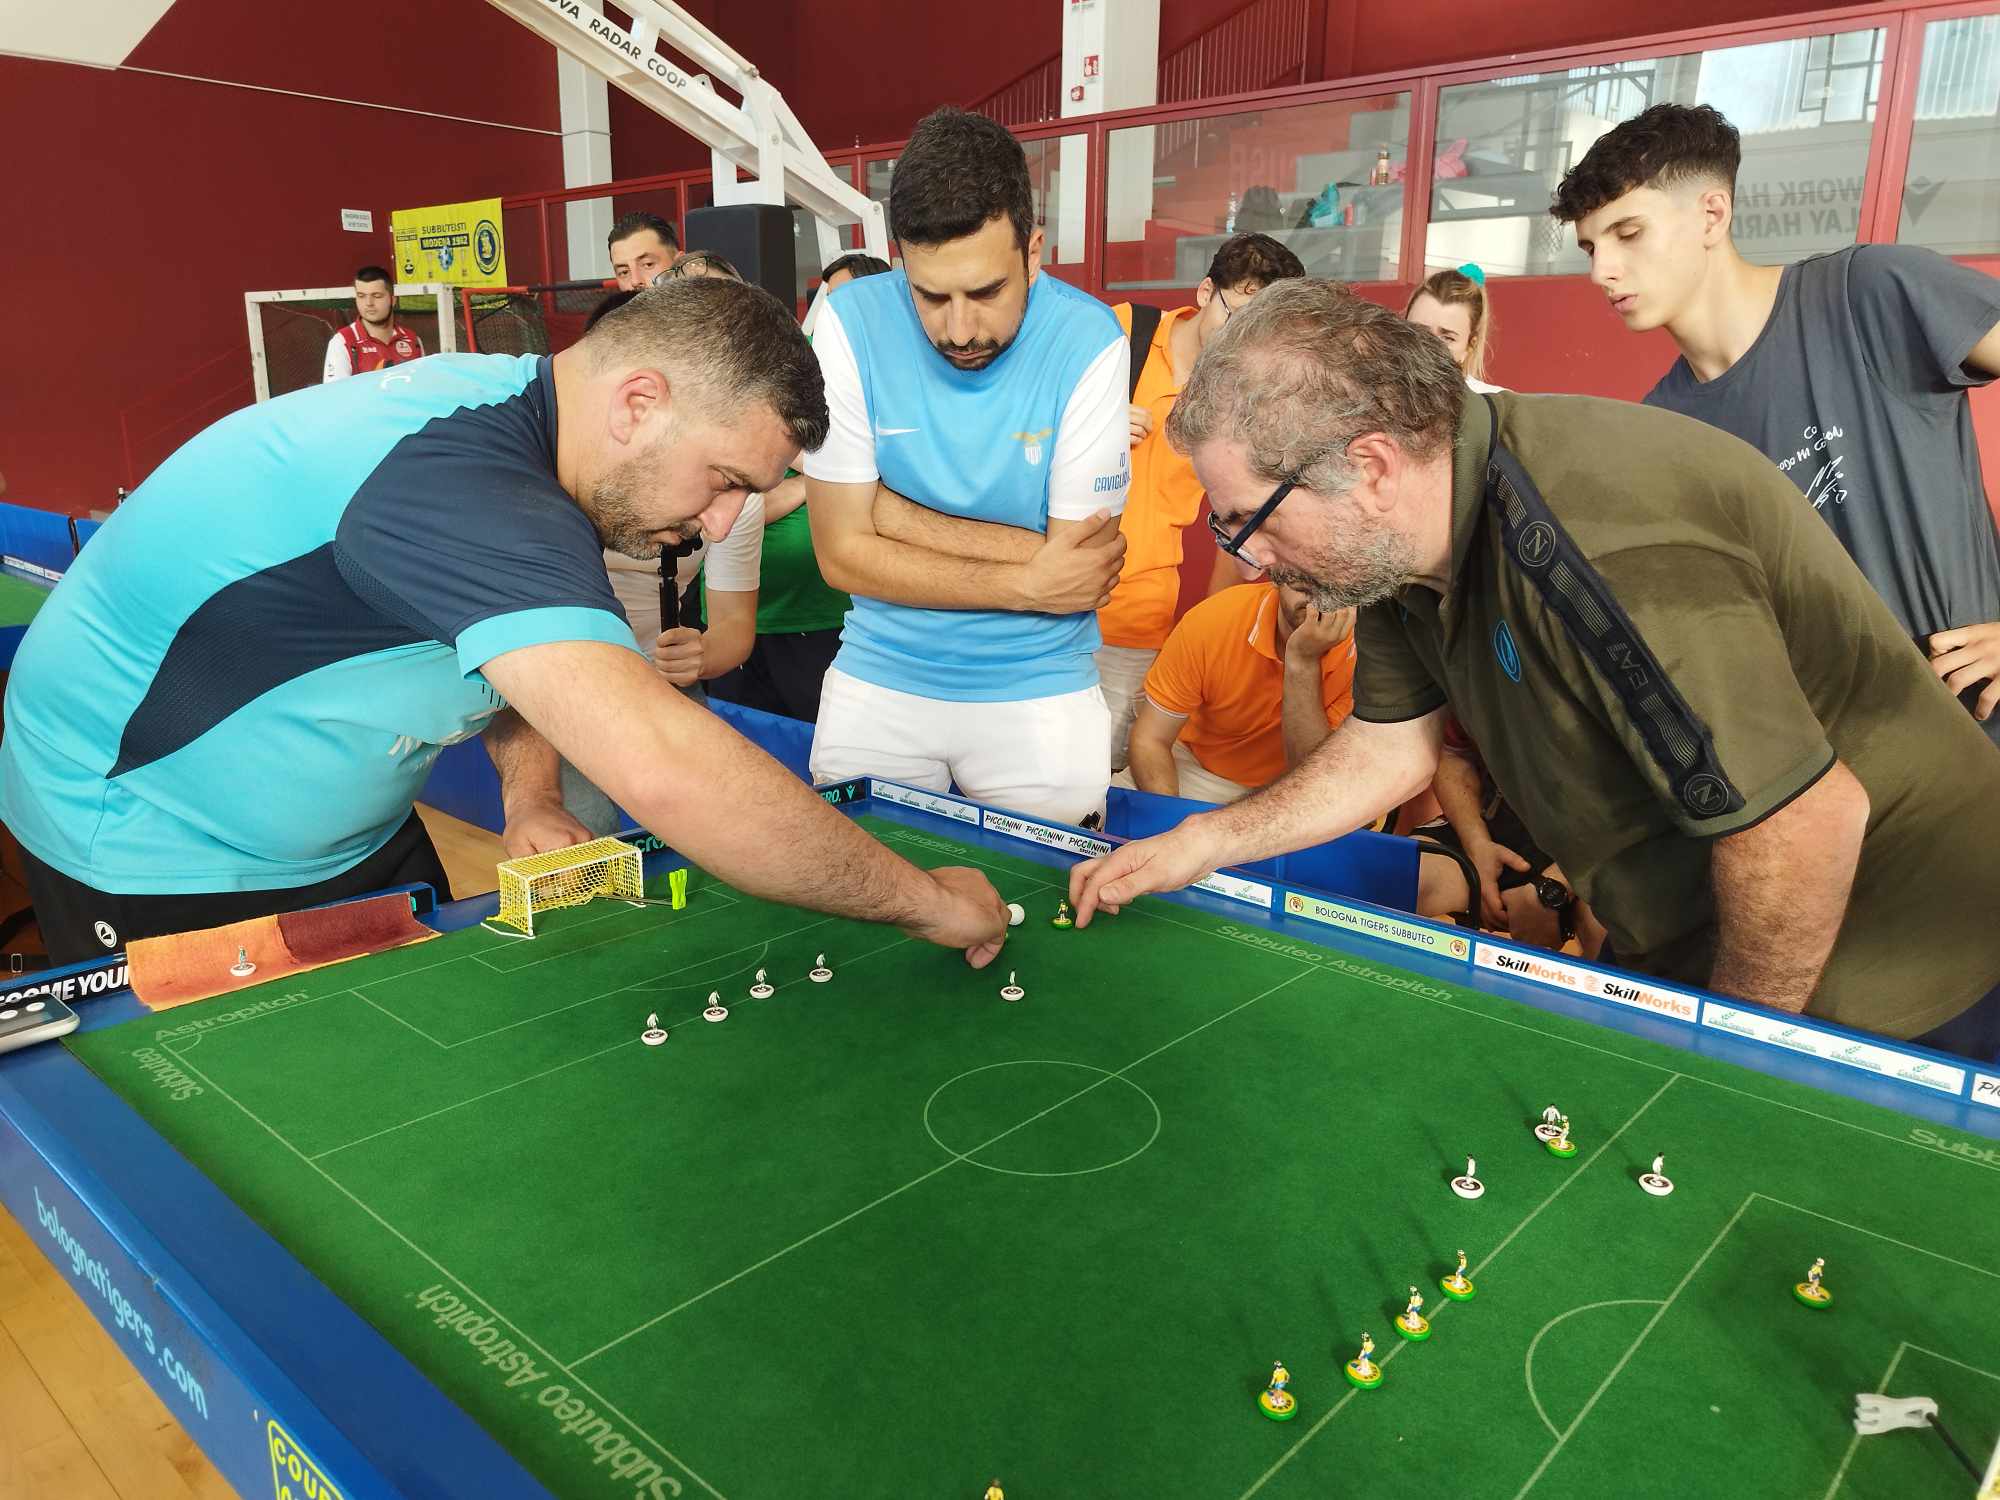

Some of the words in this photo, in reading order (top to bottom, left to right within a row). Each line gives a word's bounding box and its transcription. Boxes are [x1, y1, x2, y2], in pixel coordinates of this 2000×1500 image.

[588, 19, 642, 60] RADAR
[647, 58, 687, 89] COOP
[1314, 906, 1358, 925] BOLOGNA
[1360, 917, 1389, 933] TIGERS
[1391, 926, 1435, 945] SUBBUTEO
[1216, 925, 1323, 961] Subbuteo
[1326, 959, 1453, 1001] Astropitch
[1496, 955, 1577, 985] SkillWorks
[1603, 983, 1693, 1016] SkillWorks
[155, 990, 310, 1042] Astropitch
[131, 1047, 204, 1102] Subbuteo
[416, 1283, 549, 1388] Astropitch
[536, 1384, 683, 1500] Subbuteo
